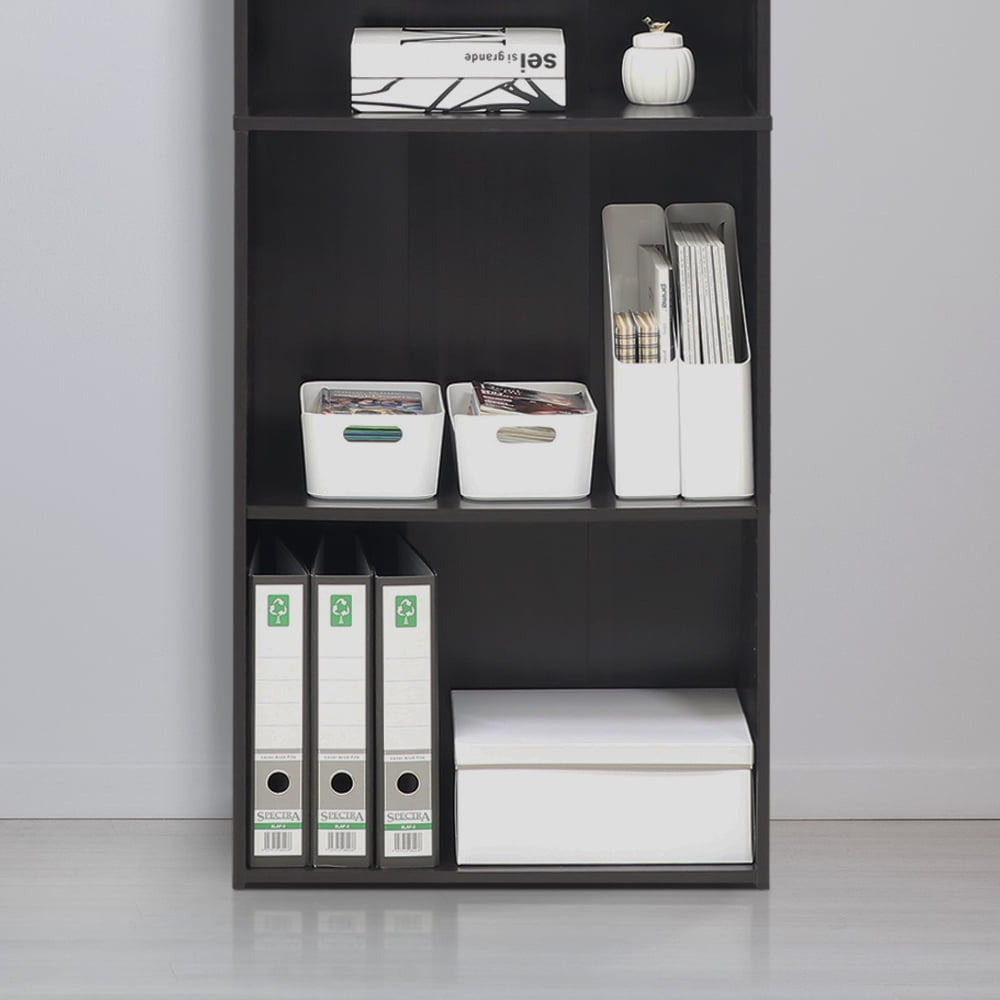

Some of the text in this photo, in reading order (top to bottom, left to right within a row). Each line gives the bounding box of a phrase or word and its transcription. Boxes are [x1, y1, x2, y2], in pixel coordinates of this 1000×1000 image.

[464, 51, 557, 74] sei si grande
[256, 810, 301, 822] SPECTRA
[320, 810, 365, 822] SPECTRA
[386, 811, 431, 823] SPECTRA
